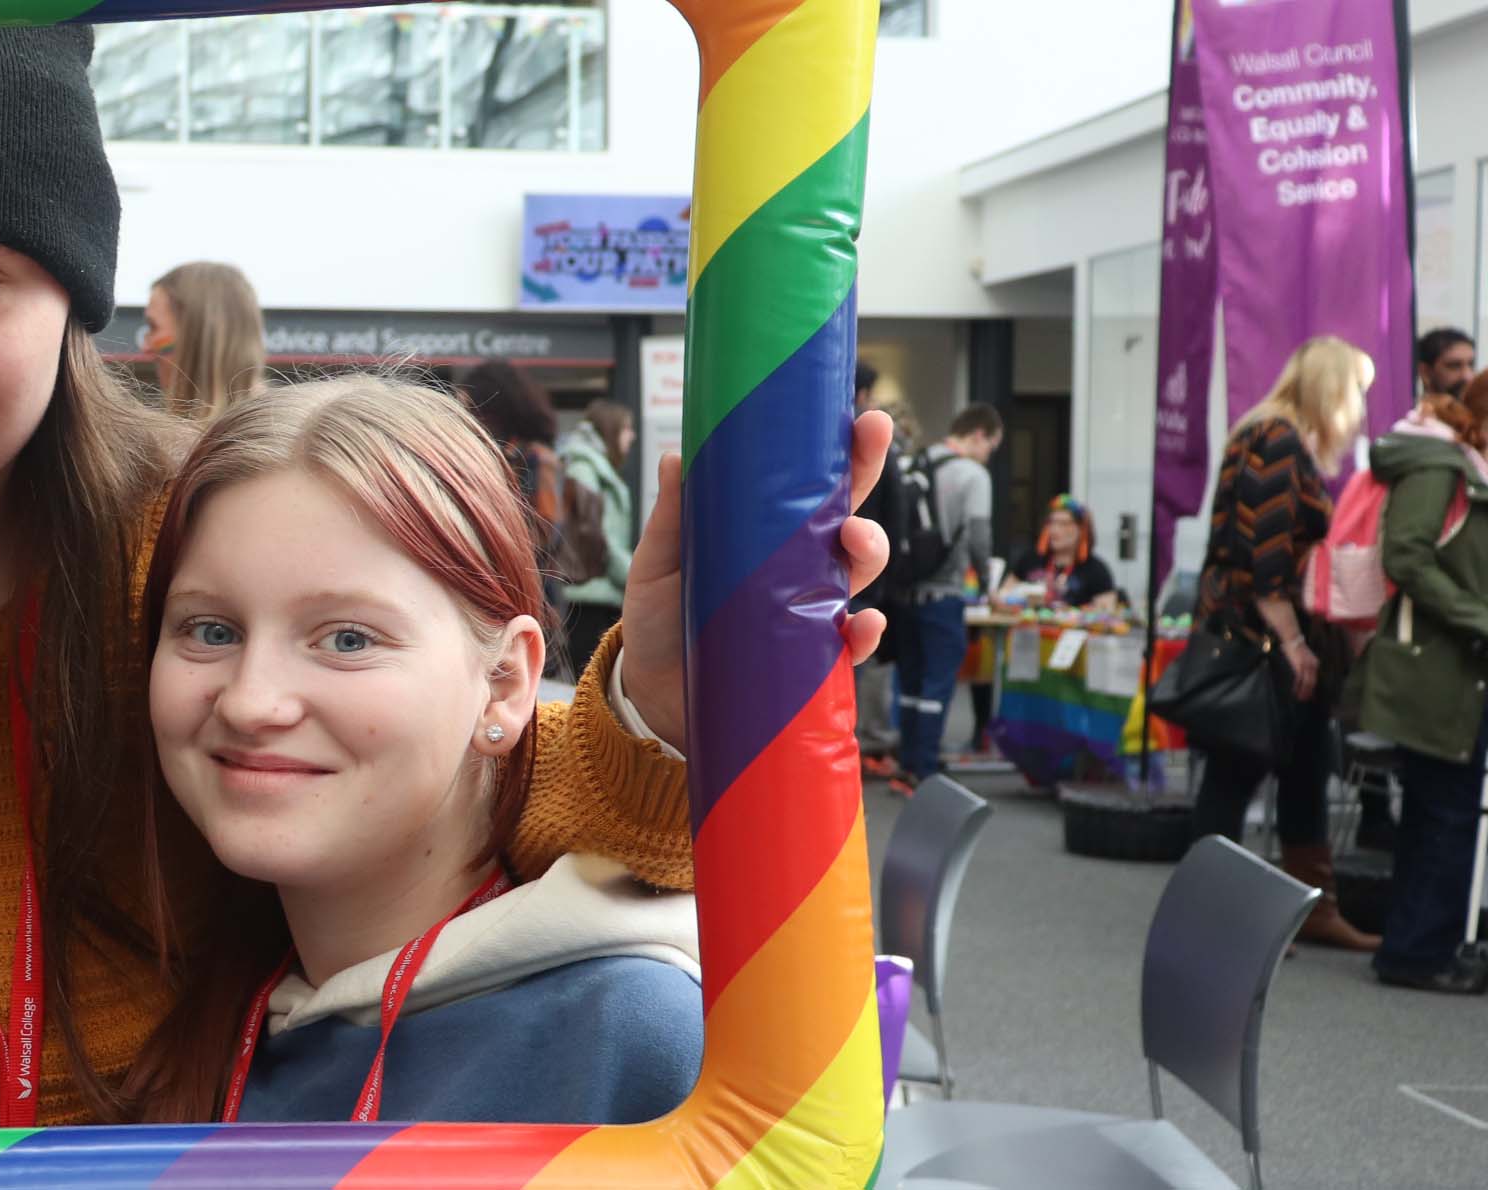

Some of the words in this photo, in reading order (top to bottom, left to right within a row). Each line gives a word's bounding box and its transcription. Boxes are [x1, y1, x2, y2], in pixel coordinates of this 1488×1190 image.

[1231, 47, 1300, 75] Walsall
[1347, 104, 1368, 131] &
[545, 250, 616, 277] YOUR
[332, 329, 375, 352] and
[476, 331, 550, 354] Centre
[21, 996, 36, 1037] College
[20, 1037, 32, 1076] Walsall
[358, 1087, 377, 1122] Colleg
